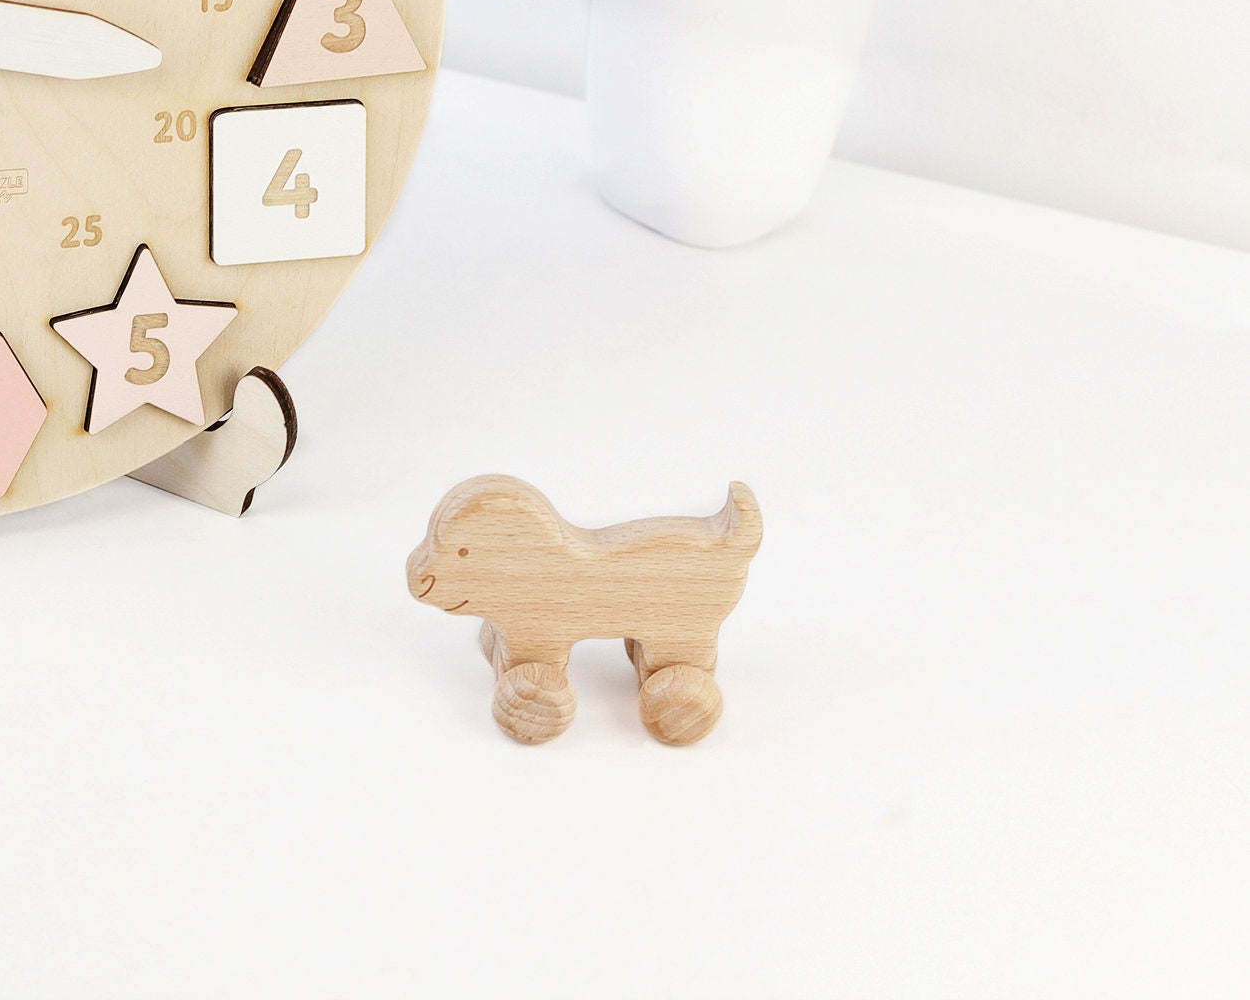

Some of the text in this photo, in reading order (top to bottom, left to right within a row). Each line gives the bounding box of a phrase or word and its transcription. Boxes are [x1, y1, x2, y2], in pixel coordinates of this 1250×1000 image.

[153, 110, 197, 143] 20
[262, 149, 318, 219] 4
[61, 215, 102, 248] 25
[124, 313, 170, 385] 5
